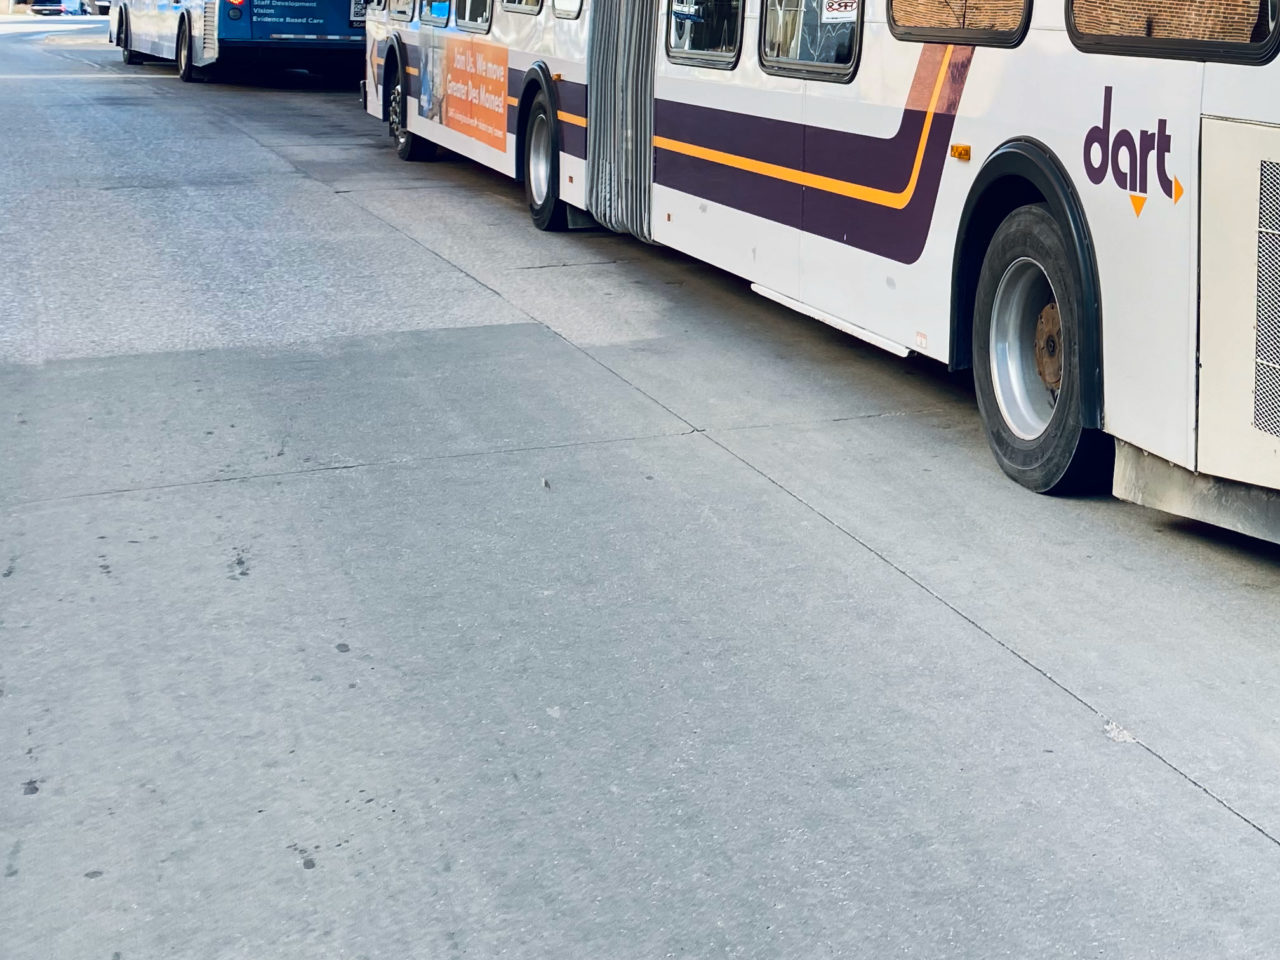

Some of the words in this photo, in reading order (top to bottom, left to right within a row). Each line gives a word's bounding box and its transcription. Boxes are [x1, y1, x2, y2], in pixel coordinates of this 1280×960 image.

[271, 0, 317, 8] Development
[252, 15, 284, 23] Evidence
[1083, 86, 1173, 200] dart
